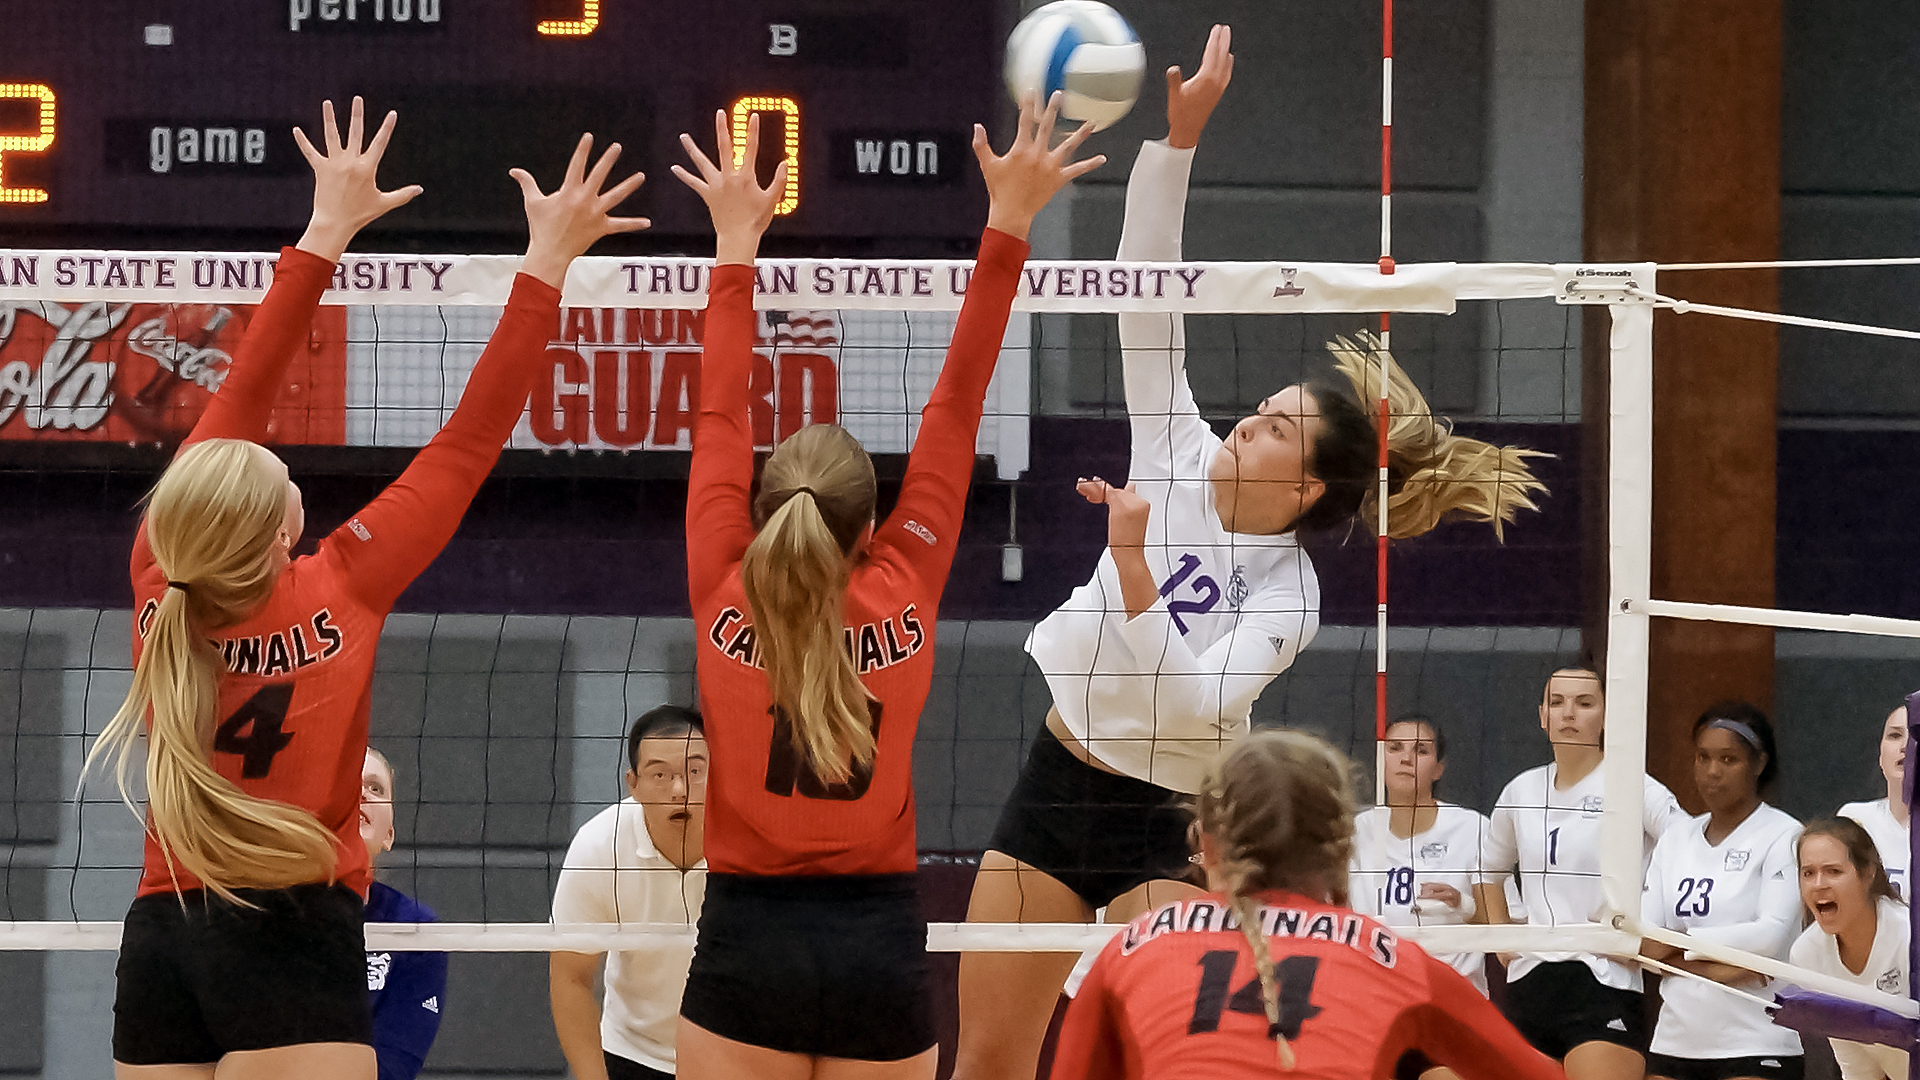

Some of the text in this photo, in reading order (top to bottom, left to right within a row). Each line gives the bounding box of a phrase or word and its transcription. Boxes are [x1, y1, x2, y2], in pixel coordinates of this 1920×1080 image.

[769, 25, 798, 56] B
[0, 83, 56, 203] 2
[150, 127, 266, 173] game
[855, 139, 939, 175] won
[55, 256, 178, 289] STATE
[192, 258, 454, 292] UNIRSITY
[621, 263, 1206, 298] TRUAN STATE UVERSITY
[548, 308, 770, 345] ATION
[1159, 552, 1221, 637] 12
[138, 597, 343, 678] CINALS
[709, 603, 926, 675] CAALS
[214, 683, 296, 780] 4
[1548, 827, 1561, 866] 1
[1385, 867, 1415, 906] 18
[1675, 877, 1715, 918] 23
[1122, 902, 1398, 968] CARDNALS
[1187, 950, 1324, 1041] 14
